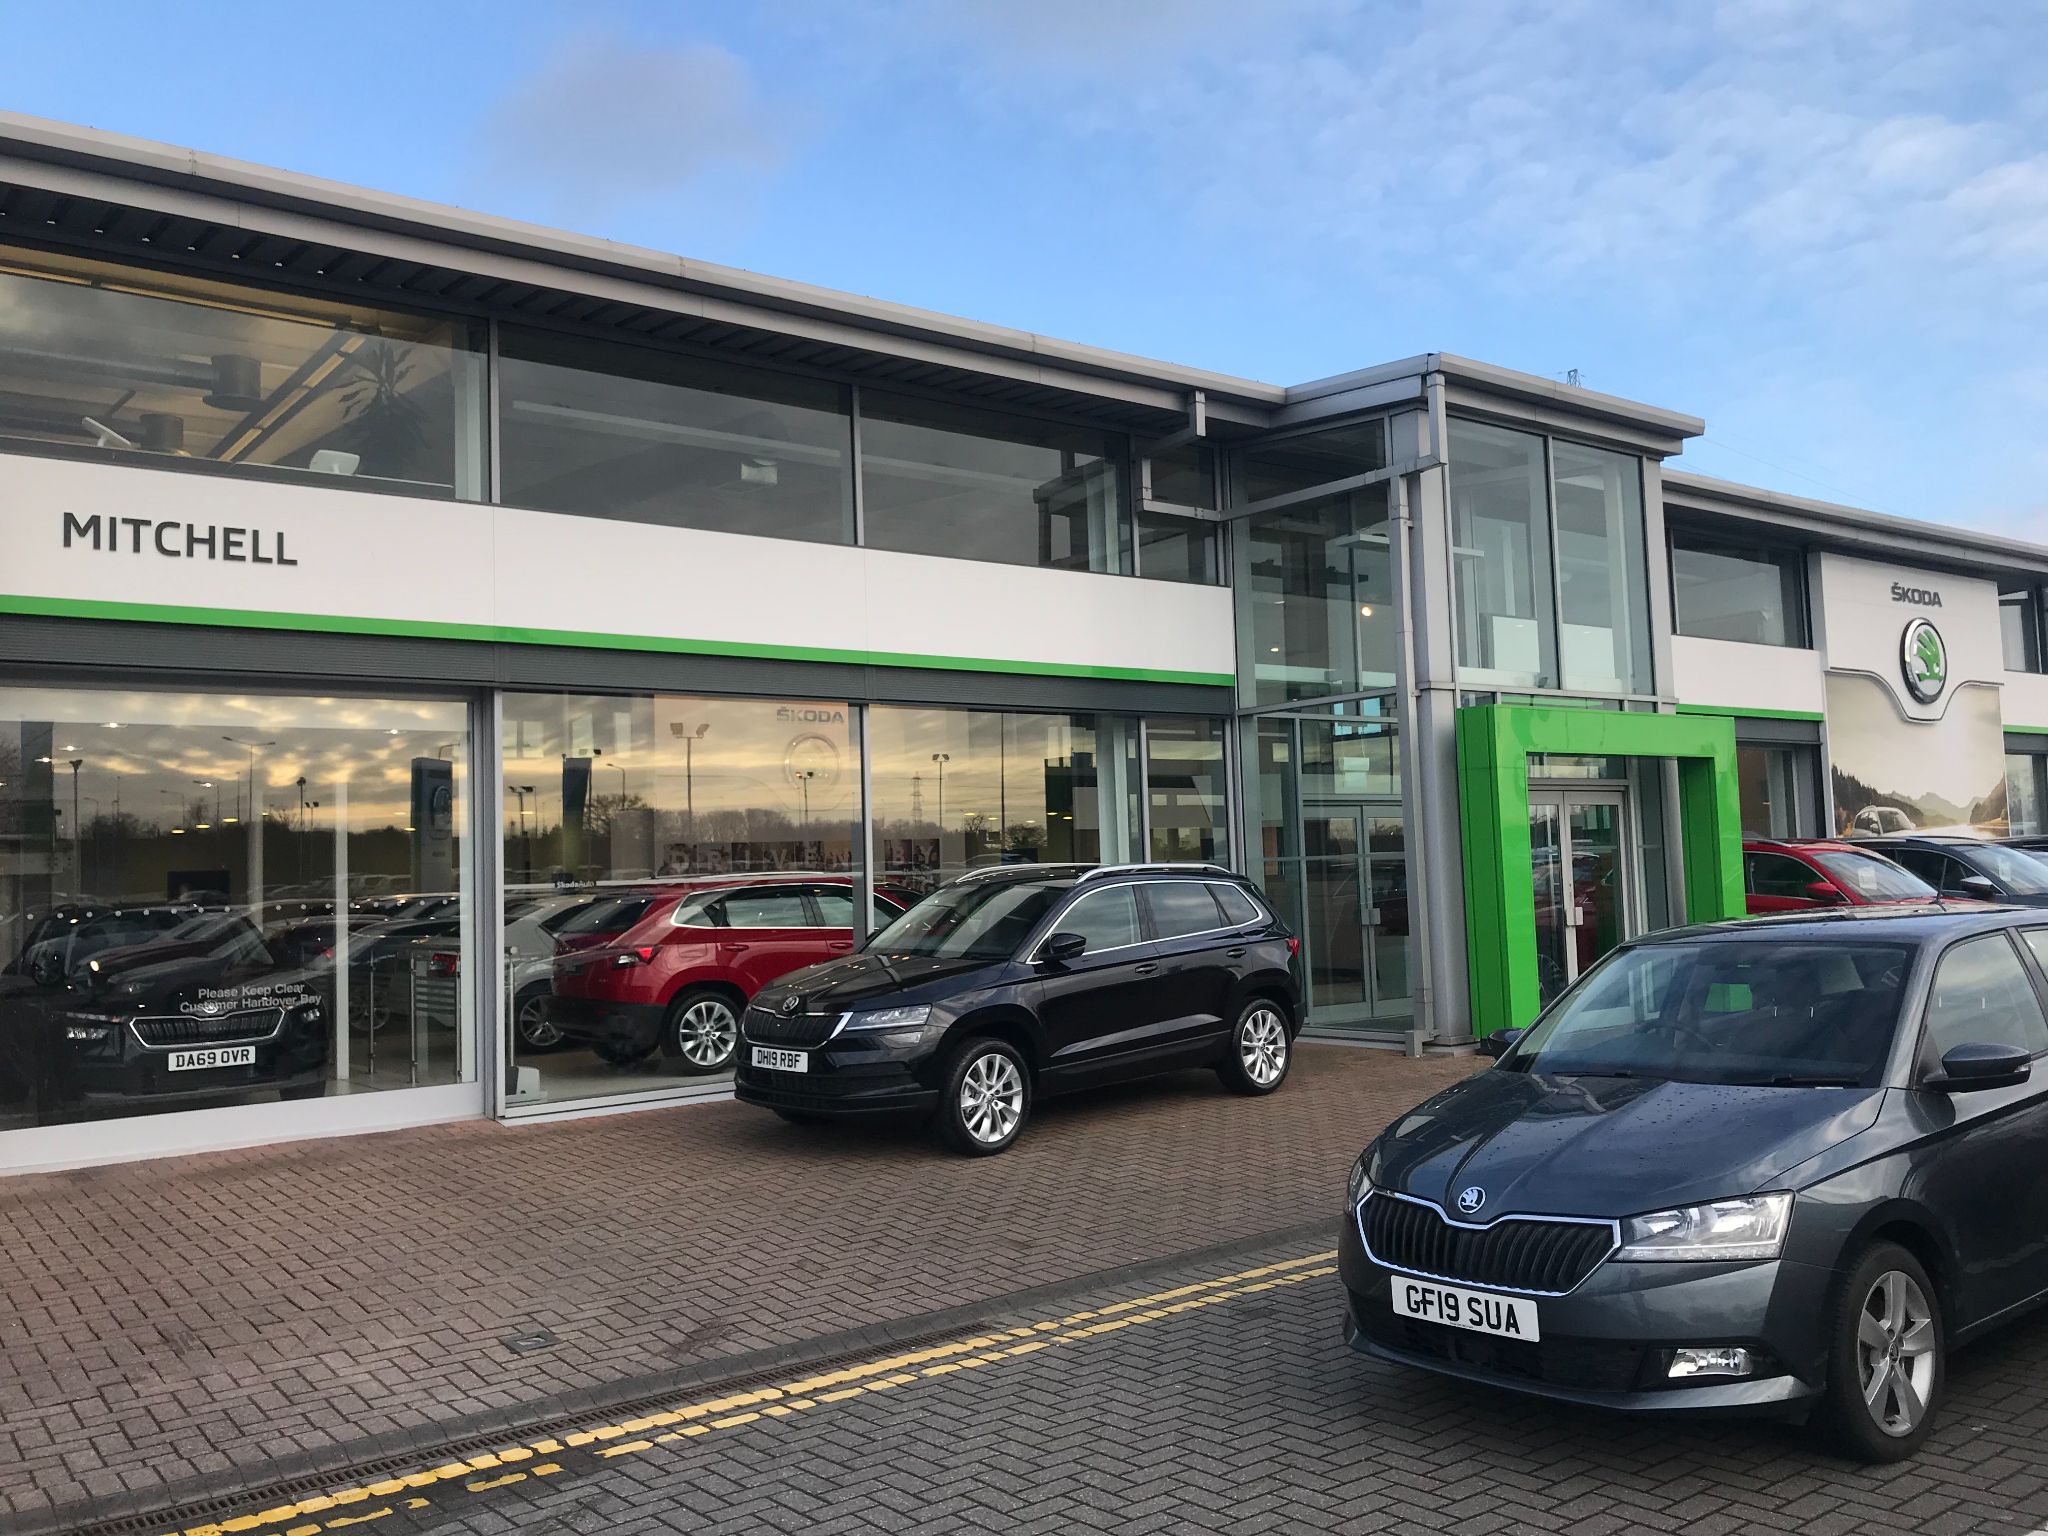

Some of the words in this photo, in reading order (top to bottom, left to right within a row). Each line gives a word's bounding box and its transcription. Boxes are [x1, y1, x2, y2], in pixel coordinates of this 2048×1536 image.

[63, 511, 298, 566] MITCHELL
[1891, 581, 1942, 608] ŠKODA
[198, 988, 238, 999] Please
[242, 986, 271, 997] Keep
[275, 983, 305, 994] Clear
[180, 1000, 238, 1013] Customer
[242, 996, 297, 1009] Handover
[300, 994, 321, 1006] Bay
[176, 1052, 216, 1068] DA69
[221, 1048, 250, 1063] OVR
[757, 1050, 777, 1066] DH19
[780, 1052, 801, 1068] RBF
[1406, 1285, 1460, 1322] GF19
[1467, 1297, 1521, 1334] SUA
